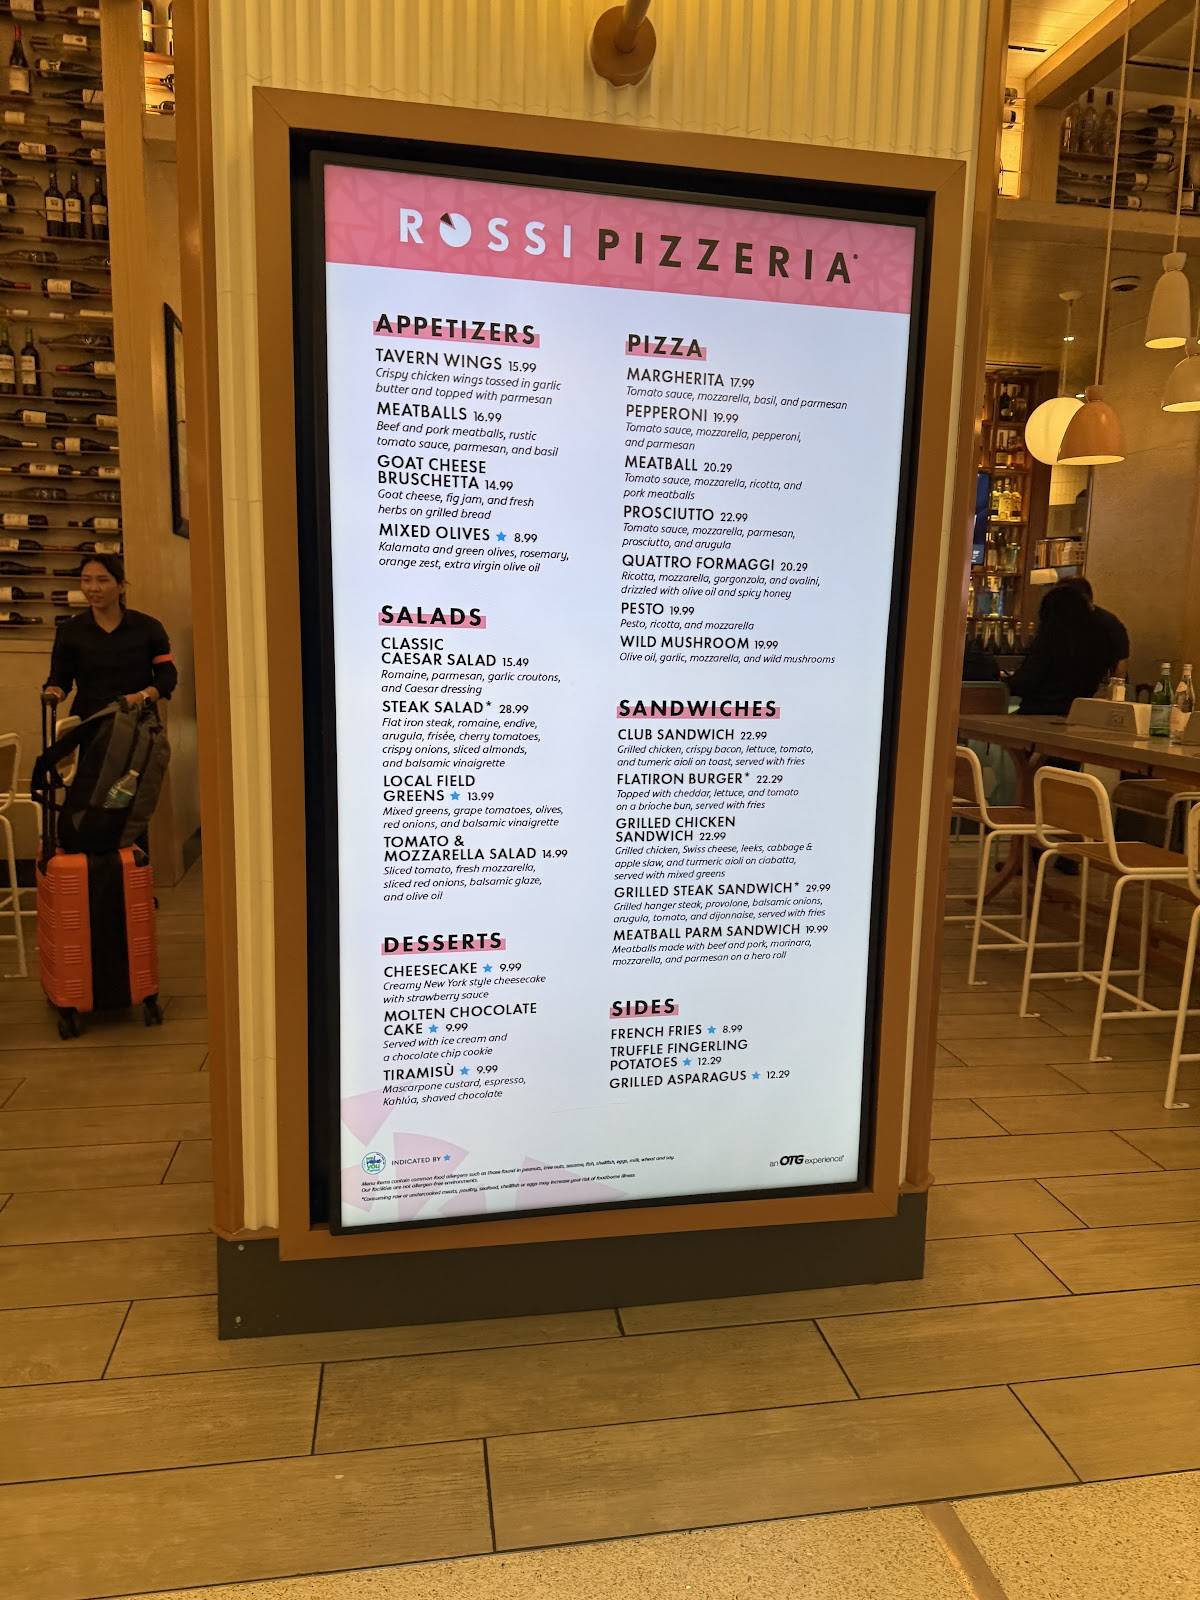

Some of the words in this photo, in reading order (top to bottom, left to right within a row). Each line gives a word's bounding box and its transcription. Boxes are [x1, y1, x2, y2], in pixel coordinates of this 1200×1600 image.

[400, 208, 572, 258] ROSSI
[598, 228, 852, 284] PIZZERIA
[376, 314, 534, 345] APPETIZERS
[628, 334, 702, 358] PIZZA
[375, 348, 439, 366] TAVERN
[443, 353, 502, 371] WINGS
[508, 361, 537, 373] 15.99
[375, 367, 409, 382] Crispy
[411, 370, 451, 383] chicken
[453, 373, 484, 388] wings
[485, 376, 520, 388] tossed
[520, 377, 531, 389] in
[532, 380, 562, 392] garlic
[626, 367, 725, 387] MARGHERITA
[730, 377, 755, 389] 17.99
[626, 385, 664, 398] Tomato
[665, 390, 695, 402] sauce,
[697, 393, 751, 407] mozzarella,
[753, 394, 778, 407] basil,
[780, 397, 800, 407] and
[800, 399, 848, 410] parmesan
[377, 401, 467, 421] MEATBALLS
[473, 411, 502, 423] 16.99
[626, 404, 708, 422] PEPPERONI
[713, 411, 739, 424] 19.99
[377, 454, 424, 470] GOAT
[428, 458, 487, 474] CHEESE
[624, 455, 698, 472] MEATBALL
[703, 462, 733, 473] 20.29
[378, 470, 480, 490] BRUSCHETTA
[484, 480, 514, 491] 14.99
[624, 505, 715, 521] PROSCIUTTO
[720, 512, 749, 523] 22.99
[379, 523, 431, 539] MIXED
[435, 526, 490, 541] OLIVES
[514, 532, 538, 544] 8.99
[622, 554, 692, 569] QUATTRO
[696, 556, 775, 572] FORMAGGI
[780, 561, 808, 572] 20.29
[382, 605, 481, 627] SALADS
[621, 602, 665, 615] PESTO
[669, 606, 695, 616] 19.99
[381, 636, 444, 651] CLASSIC
[620, 635, 657, 648] WILD
[660, 636, 750, 650] MUSHROOM
[754, 640, 779, 650] 19.99
[381, 652, 443, 666] CAESAR
[447, 653, 497, 667] SALAD
[502, 657, 530, 667] 15.49
[382, 700, 430, 713] STEAK
[499, 704, 529, 714] 28.99
[619, 700, 776, 717] SANDWICHES
[382, 717, 403, 727] Flat
[403, 717, 424, 727] iron
[425, 718, 455, 729] steak,
[457, 718, 501, 730] romaine,
[503, 718, 538, 730] endive,
[382, 731, 425, 743] arugula,
[459, 732, 491, 743] cherry
[492, 732, 541, 743] tomatoes,
[617, 728, 653, 741] CLUB
[657, 728, 735, 741] SANDWICH
[740, 731, 768, 741] 22.99
[617, 744, 647, 754] Grilled
[648, 744, 684, 755] chicken,
[685, 744, 713, 756] crispy
[713, 745, 744, 756] bacon,
[745, 745, 778, 755] lettuce,
[779, 745, 814, 755] tomato,
[384, 774, 433, 787] LOCAL
[437, 774, 476, 787] FIELD
[617, 773, 684, 785] FLATIRON
[756, 774, 784, 784] 22.29
[383, 789, 445, 802] GREENS
[467, 791, 495, 801] 13.99
[616, 817, 671, 829] GRILLED
[675, 816, 736, 829] CHICKEN
[383, 835, 449, 848] TOMATO
[453, 835, 465, 847] &
[615, 830, 694, 843] SANDWICH
[699, 831, 727, 841] 22.99
[384, 848, 485, 863] MOZZARELLA
[489, 847, 537, 860] SALAD
[541, 849, 568, 859] 14.99
[614, 885, 669, 898] GRILLED
[673, 884, 714, 897] STEAK
[805, 883, 831, 893] 29.99
[613, 901, 643, 911] Grilled
[643, 901, 678, 912] hanger
[677, 900, 703, 910] steak,
[704, 899, 750, 910] provolone,
[752, 897, 792, 907] balsamic
[792, 896, 823, 907] onions,
[613, 927, 682, 942] MEATBALL
[685, 926, 723, 939] PARM
[726, 923, 801, 937] SANDWICH
[805, 925, 829, 935] 19.99
[384, 932, 501, 953] DESSERTS
[384, 962, 478, 978] CHEESECAKE
[499, 962, 522, 973] 9.99
[383, 982, 422, 992] Creamy
[423, 979, 446, 989] New
[447, 978, 468, 988] York
[469, 977, 492, 989] style
[493, 974, 547, 985] cheesecake
[384, 1007, 446, 1023] MOLTEN
[449, 1002, 537, 1018] CHOCOLATE
[612, 998, 675, 1017] SIDES
[384, 1022, 423, 1036] CAKE
[445, 1022, 469, 1033] 9.99
[611, 1026, 664, 1040] FRENCH
[668, 1024, 702, 1037] FRIES
[722, 1024, 743, 1034] 8.99
[610, 1043, 664, 1058] TRUFFLE
[667, 1039, 748, 1056] FINGERLING
[383, 1062, 454, 1081] TIRAMISÙ
[476, 1064, 499, 1075] 9.99
[610, 1056, 678, 1072] POTATOES
[697, 1056, 722, 1069] 12.29
[609, 1075, 663, 1089] GRILLED
[667, 1069, 747, 1086] ASPARAGUS
[766, 1070, 791, 1079] 12.29
[421, 1092, 457, 1104] shaved
[458, 1089, 503, 1101] chocolate
[780, 1155, 804, 1166] OTG
